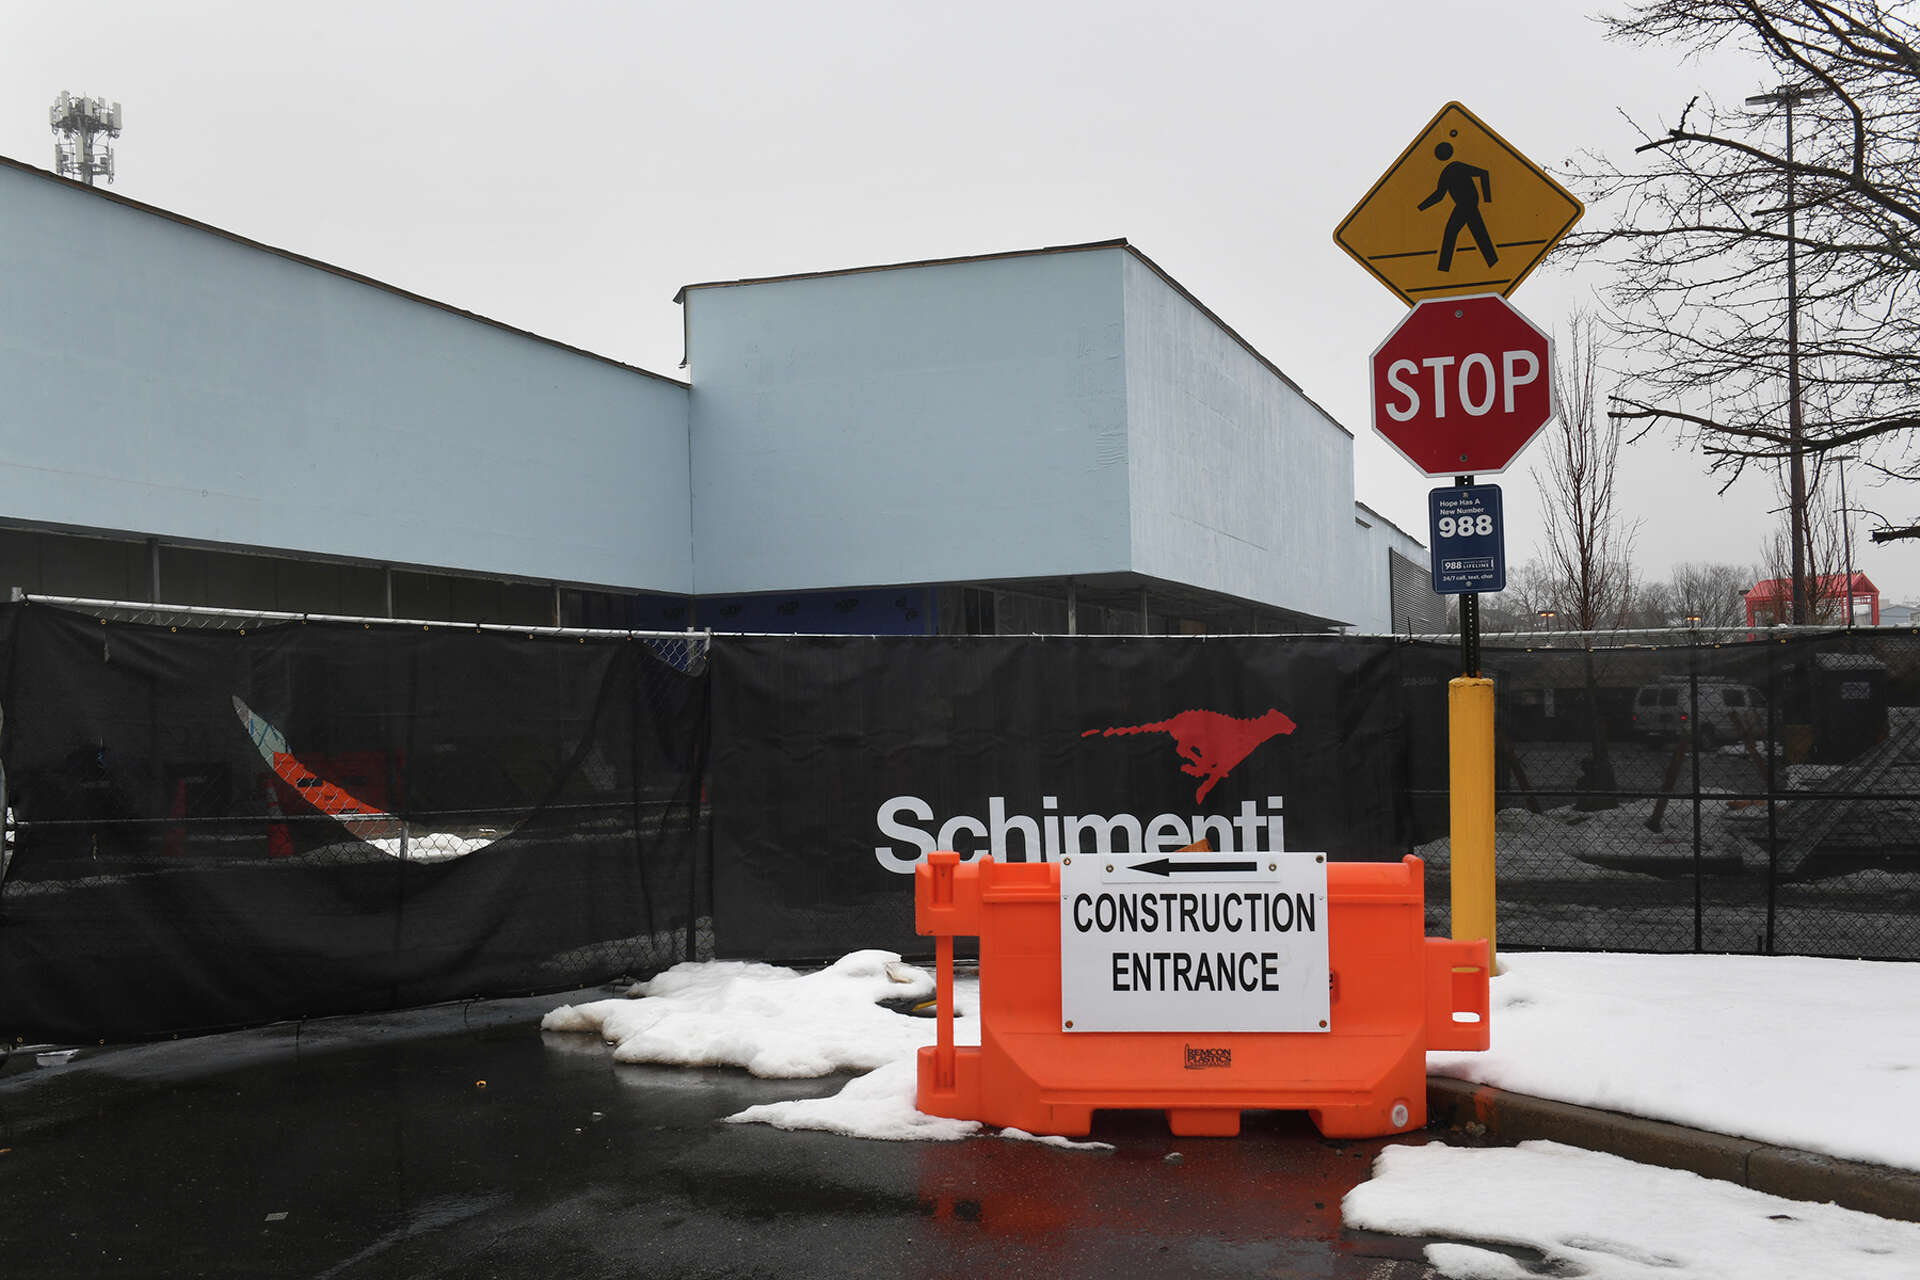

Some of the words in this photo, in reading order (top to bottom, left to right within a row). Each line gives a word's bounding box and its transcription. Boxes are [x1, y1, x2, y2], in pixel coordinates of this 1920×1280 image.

[1386, 349, 1540, 421] STOP
[1439, 514, 1493, 538] 988
[1444, 561, 1462, 570] 988
[875, 796, 1283, 874] Schimenti
[1073, 892, 1316, 933] CONSTRUCTION
[1112, 951, 1280, 992] ENTRANCE
